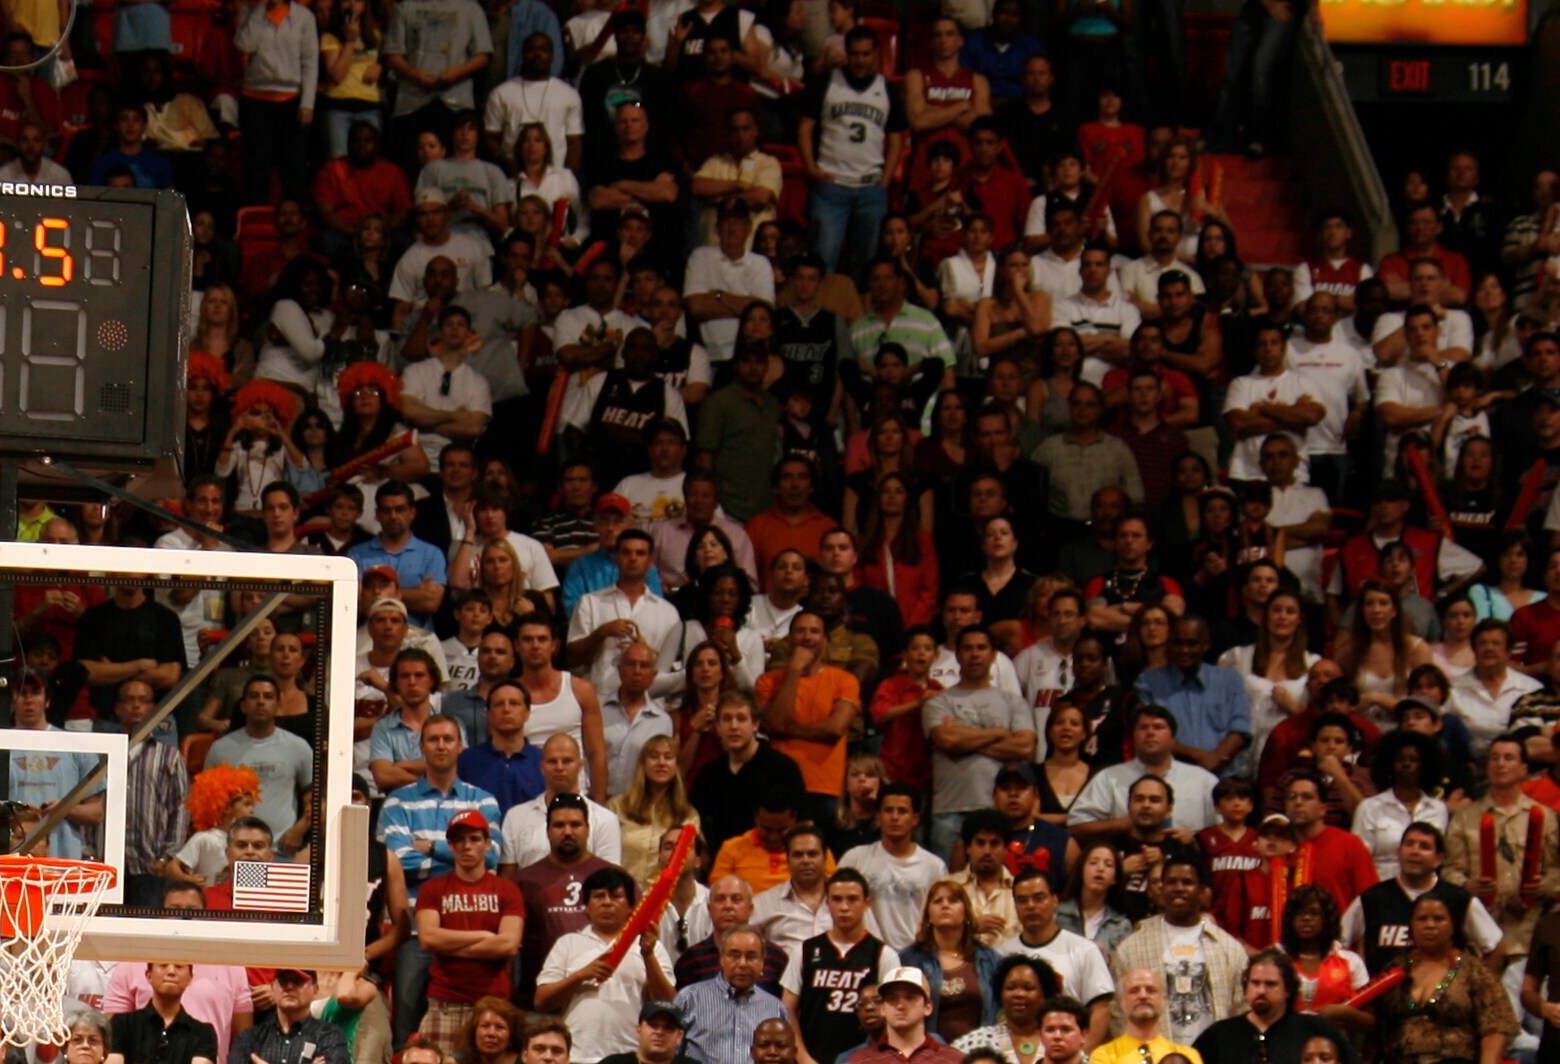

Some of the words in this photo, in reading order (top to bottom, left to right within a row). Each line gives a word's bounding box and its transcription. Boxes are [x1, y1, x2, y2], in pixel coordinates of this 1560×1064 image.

[1389, 60, 1430, 91] EXIT
[1468, 62, 1510, 92] 114
[849, 122, 866, 144] 3
[601, 403, 655, 430] HEAT
[441, 893, 501, 915] MALIBU
[563, 881, 584, 906] 3
[813, 967, 871, 990] HEAT
[826, 990, 859, 1013] 32
